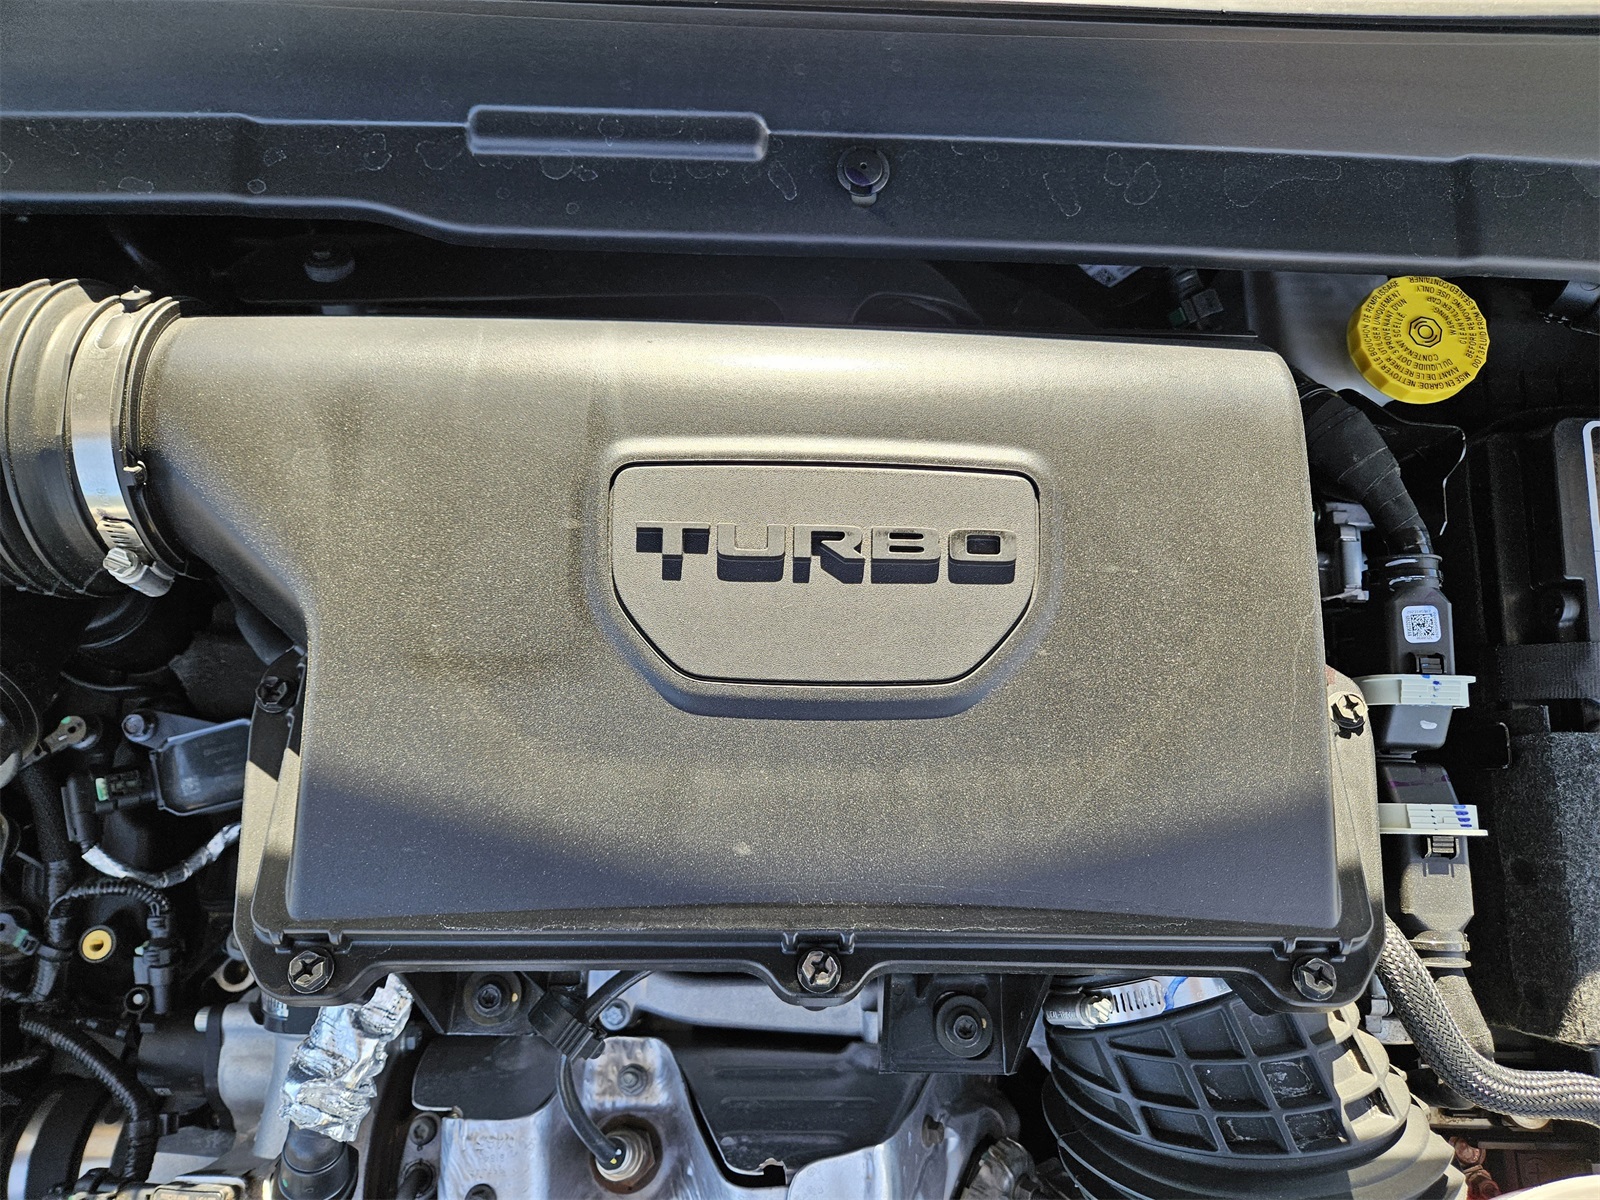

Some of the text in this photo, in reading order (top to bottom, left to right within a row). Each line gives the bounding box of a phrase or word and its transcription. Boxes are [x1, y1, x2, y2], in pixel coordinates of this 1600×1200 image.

[1365, 280, 1400, 313] REMPLISSAGE
[1416, 286, 1435, 294] ONLY
[1437, 289, 1451, 300] USE
[1450, 286, 1474, 306] SEALED
[1373, 291, 1401, 326] UNIQUEMENT
[1391, 298, 1408, 311] D'UN
[1362, 313, 1372, 323] DE
[1426, 296, 1467, 345] CLEAN FILLER CAP
[1474, 311, 1486, 331] FROM
[1382, 310, 1395, 350] PROVENANT
[1362, 324, 1377, 357] BOUCHON
[1372, 327, 1388, 356] UTILISER
[1465, 333, 1477, 359] BEFORE
[1478, 331, 1488, 350] FLUID
[1396, 339, 1439, 362] CONTENANT
[1373, 356, 1384, 366] LE
[1397, 354, 1412, 367] DOT
[1413, 361, 1443, 371] LIQUIDE
[1443, 358, 1454, 369] DU
[1472, 355, 1484, 369] DOT
[1381, 364, 1416, 387] NETTOYER
[1416, 372, 1425, 380] LE
[1427, 373, 1437, 381] DE
[1439, 366, 1460, 380] AVANT
[1454, 371, 1471, 384] MISE
[1445, 379, 1456, 388] EN
[636, 521, 1018, 577] TURBO
